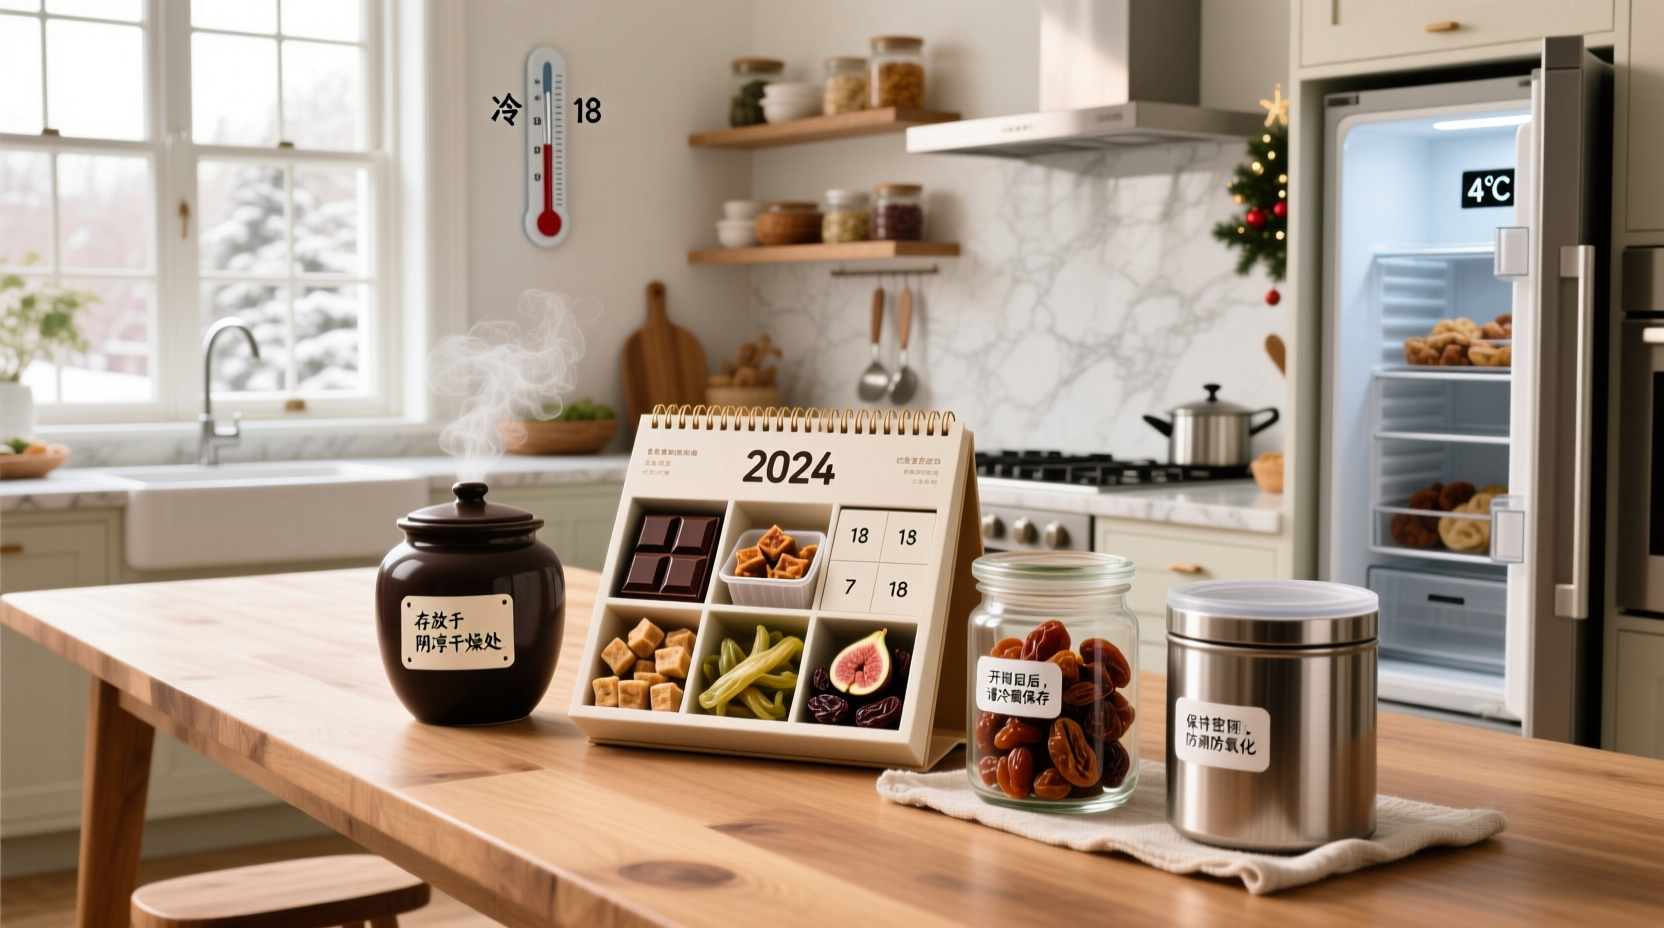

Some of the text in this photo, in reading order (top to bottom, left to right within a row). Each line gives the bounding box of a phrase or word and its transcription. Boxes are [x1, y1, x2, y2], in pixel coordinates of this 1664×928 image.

[491, 92, 523, 127] 冷
[573, 97, 602, 124] 18
[1467, 174, 1511, 203] 4°C
[742, 448, 836, 486] 2024
[851, 527, 869, 544] 18
[898, 528, 917, 546] 18
[845, 578, 857, 595] 7
[889, 581, 908, 598] 18
